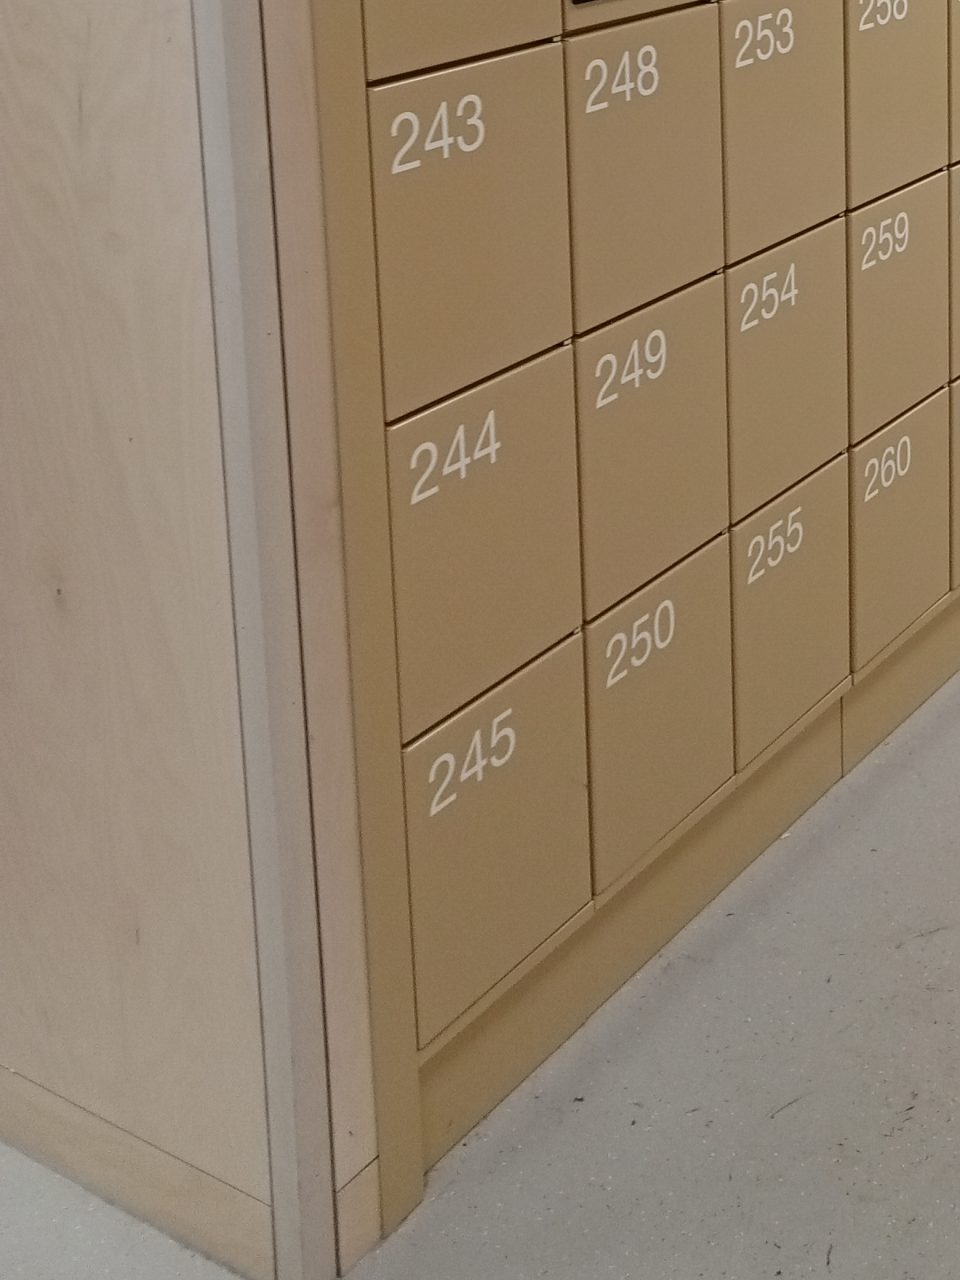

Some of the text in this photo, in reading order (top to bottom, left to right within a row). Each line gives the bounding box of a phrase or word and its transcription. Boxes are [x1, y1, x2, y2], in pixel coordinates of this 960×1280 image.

[734, 8, 795, 69] 253
[585, 44, 659, 114] 248
[391, 94, 485, 175] 243
[861, 211, 909, 271] 259
[740, 262, 799, 332] 254
[595, 329, 667, 409] 249
[410, 409, 501, 505] 244
[864, 435, 911, 502] 260
[747, 506, 803, 585] 255
[606, 599, 675, 688] 250
[428, 708, 516, 817] 245
